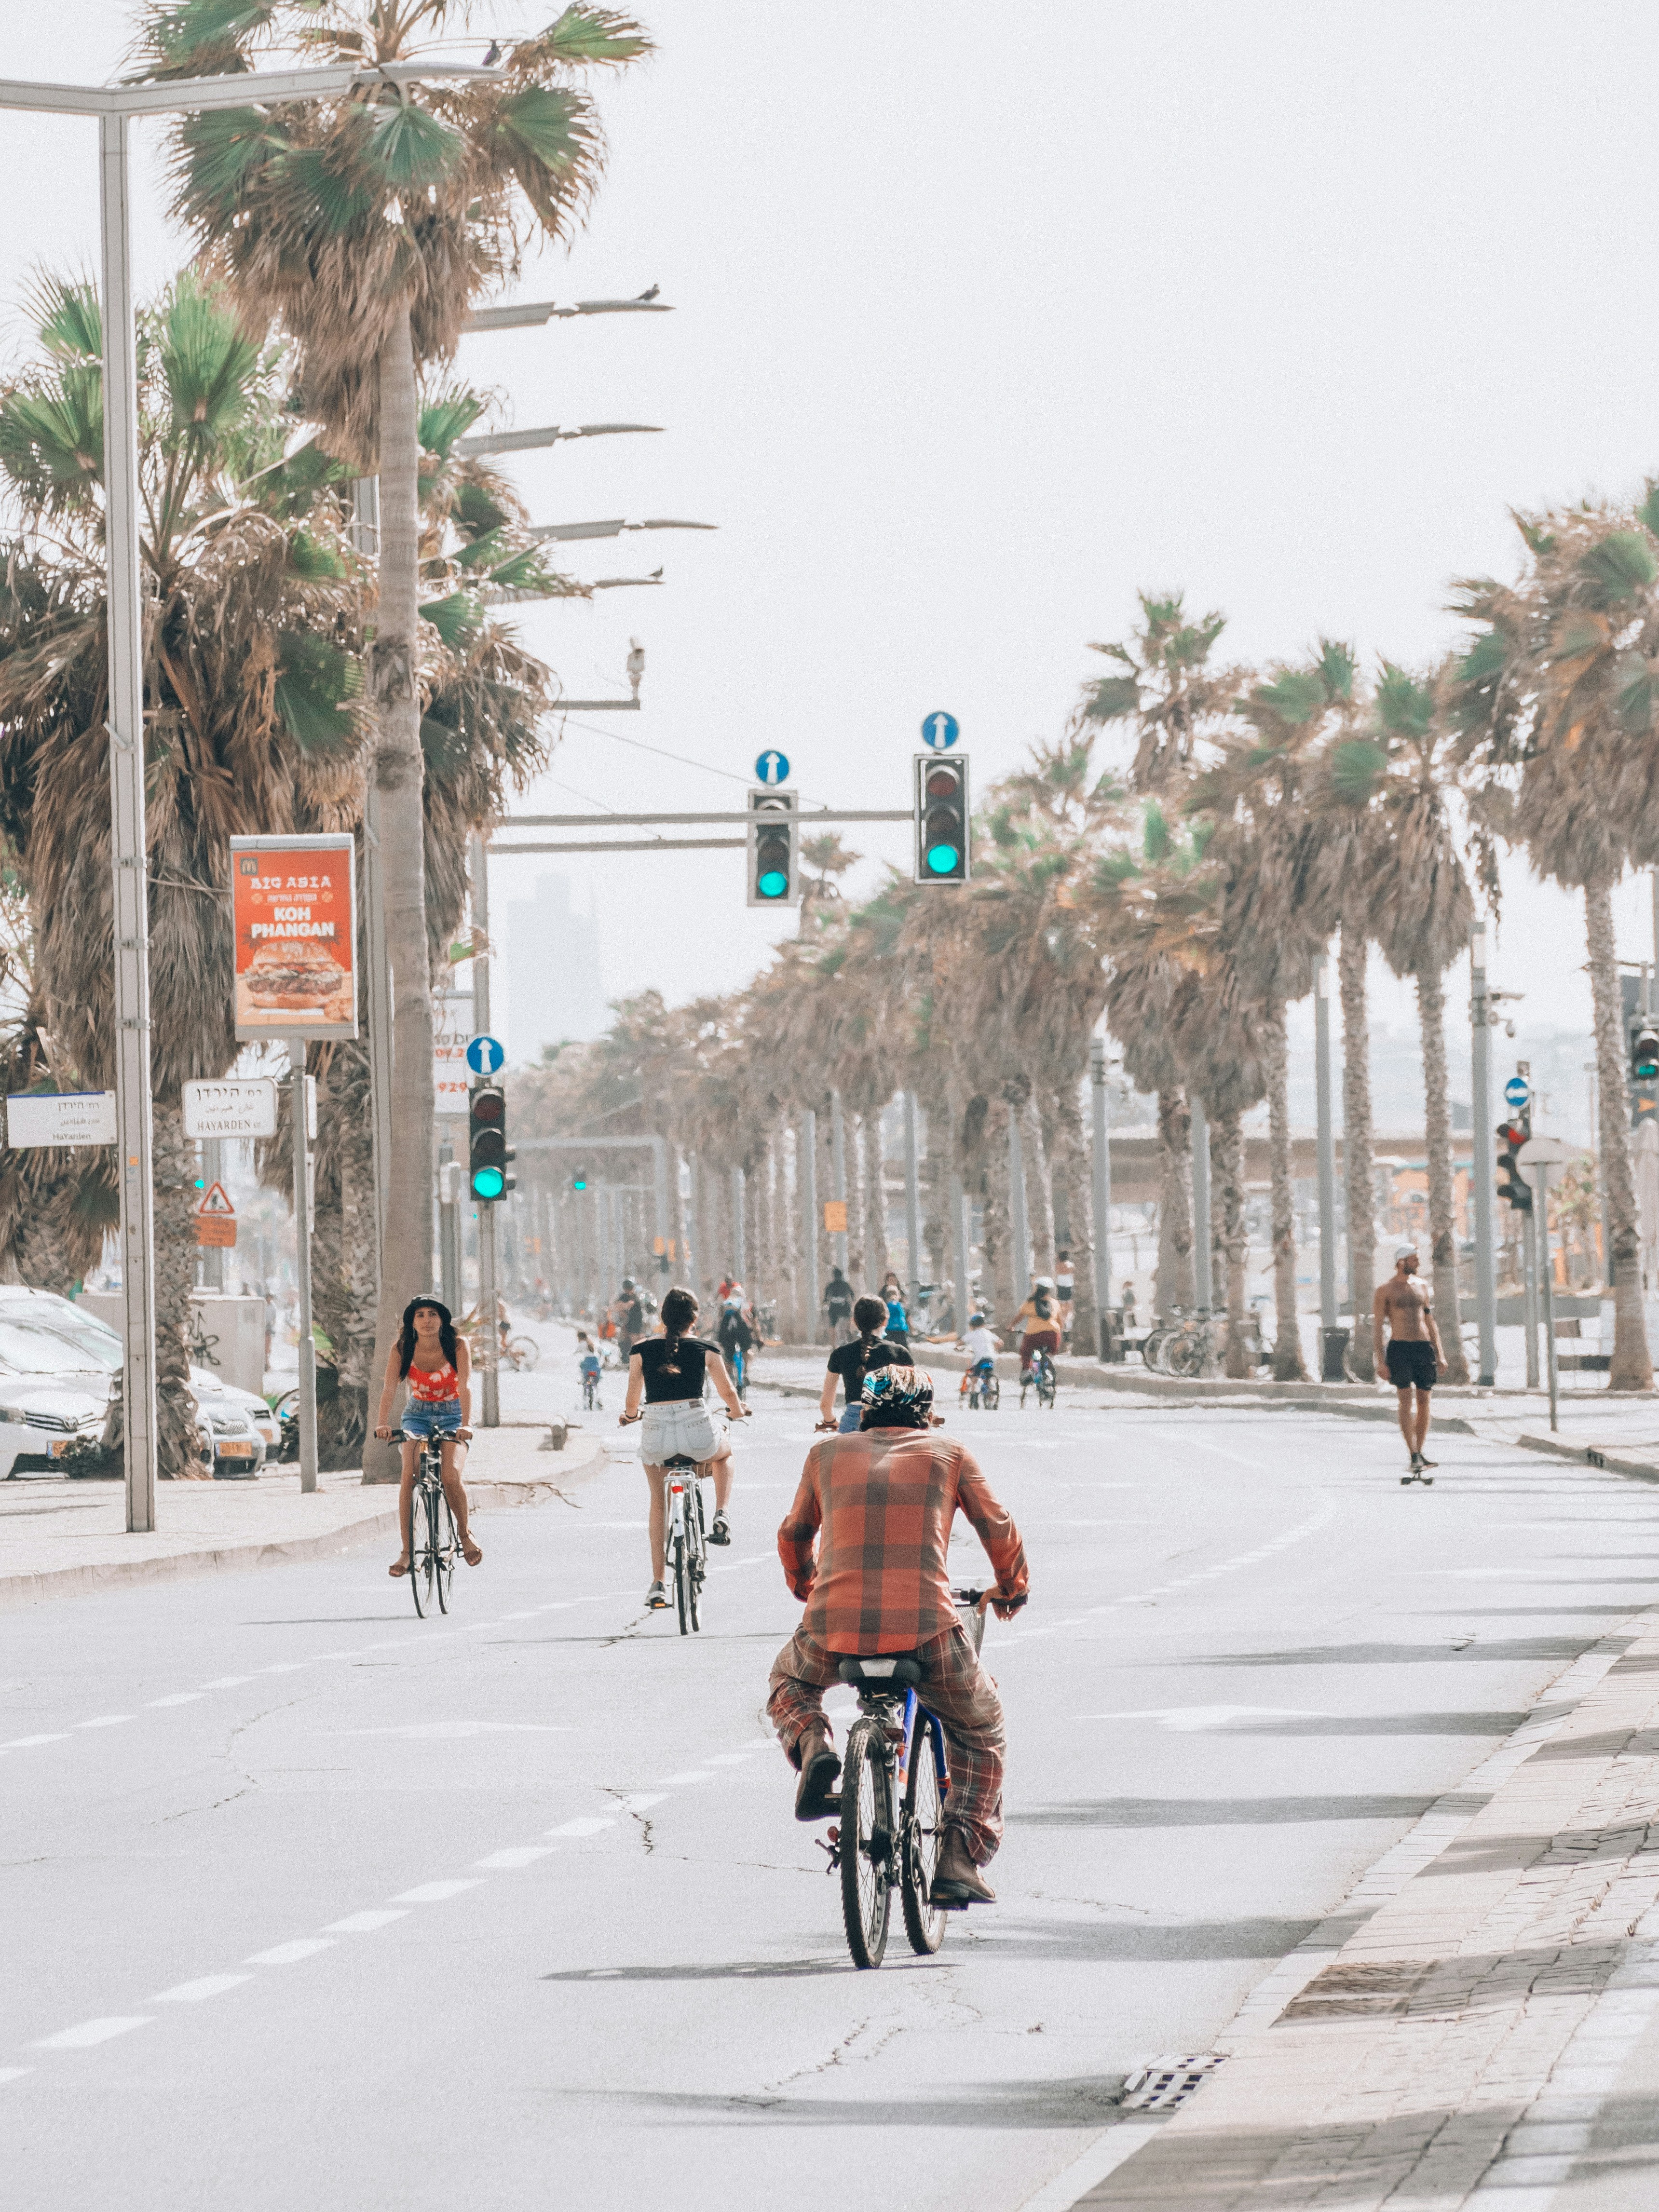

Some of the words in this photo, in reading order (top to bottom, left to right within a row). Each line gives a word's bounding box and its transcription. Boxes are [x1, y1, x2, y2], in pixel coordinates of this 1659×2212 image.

[251, 876, 281, 889] BIG
[286, 875, 332, 888] ASIA
[274, 906, 311, 922] KOH
[251, 922, 335, 938] PHANGAN
[197, 1087, 239, 1101] הירדן
[57, 1101, 84, 1112] הירדן
[198, 1119, 250, 1131] HAYARDEN
